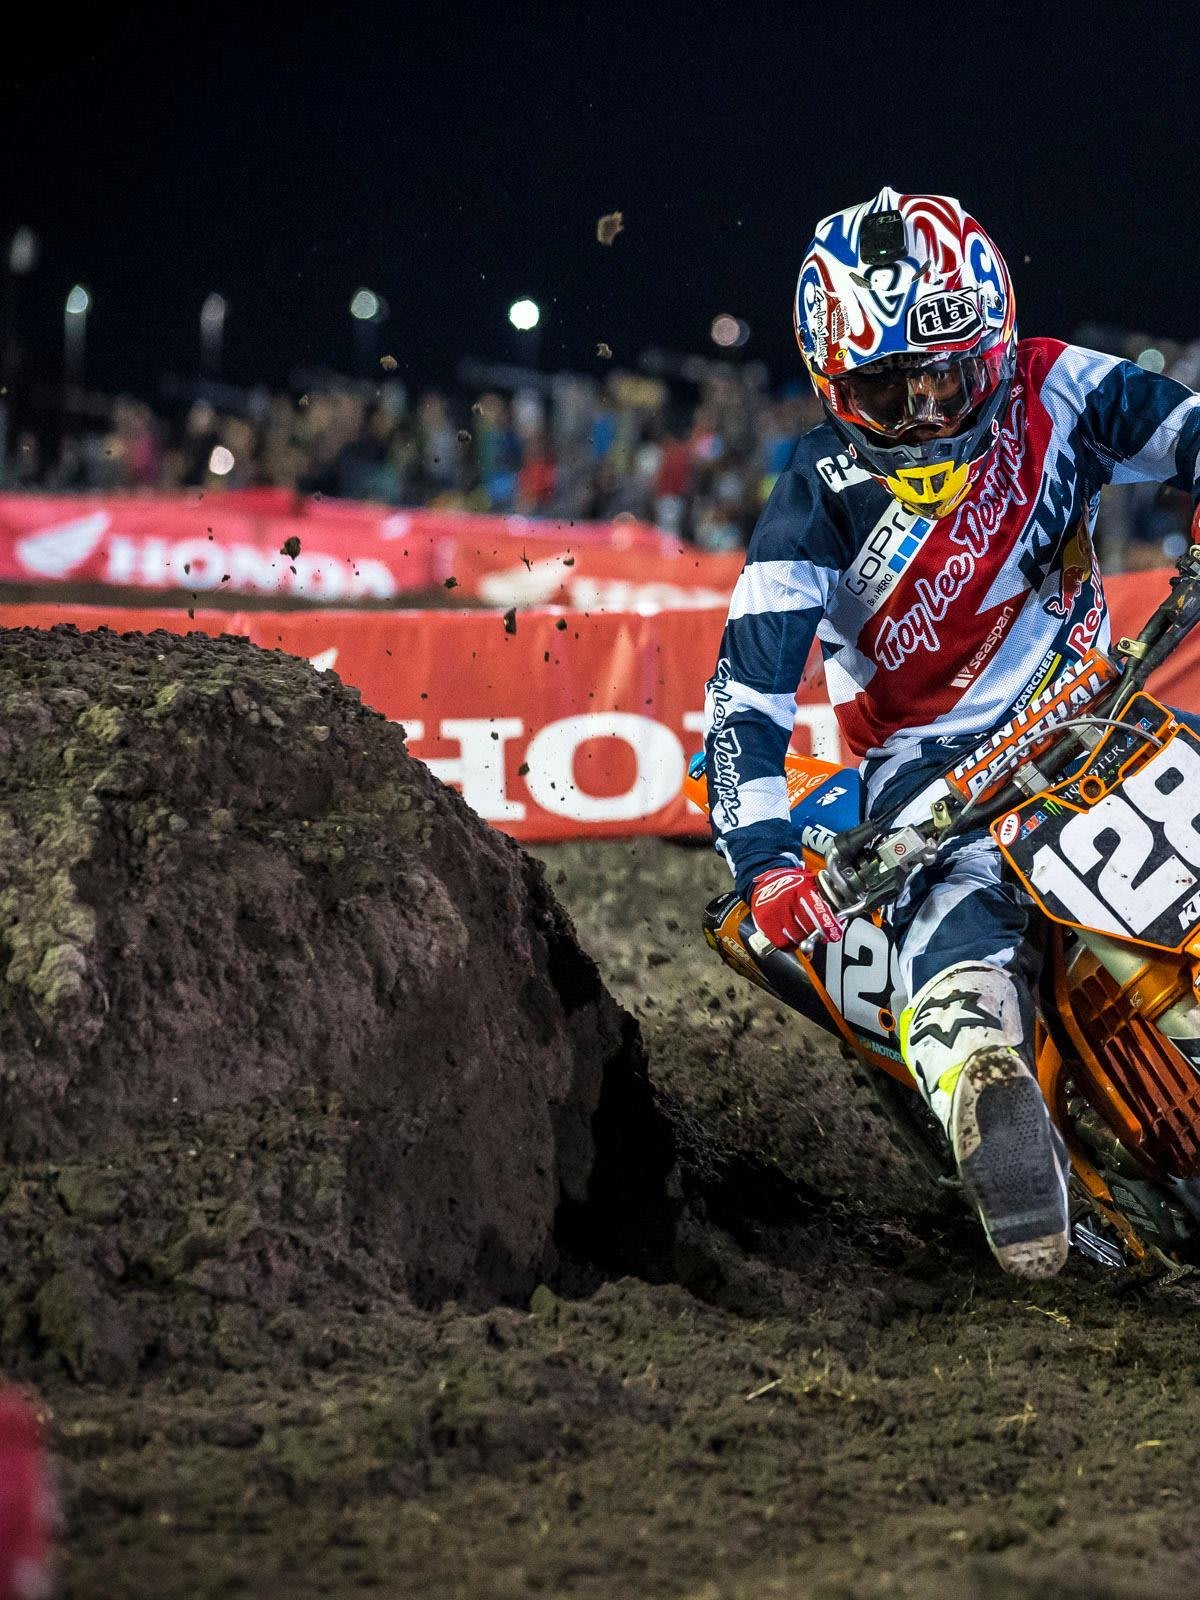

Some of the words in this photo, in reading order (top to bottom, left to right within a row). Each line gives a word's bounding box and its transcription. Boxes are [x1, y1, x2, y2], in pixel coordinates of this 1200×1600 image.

[875, 603, 940, 670] Troy
[914, 552, 975, 621] Lee
[949, 399, 1027, 558] Designs
[969, 606, 1014, 669] seaspan
[953, 658, 1095, 780] RENTHAL
[1059, 744, 1125, 801] MOSTER
[802, 824, 837, 854] KT
